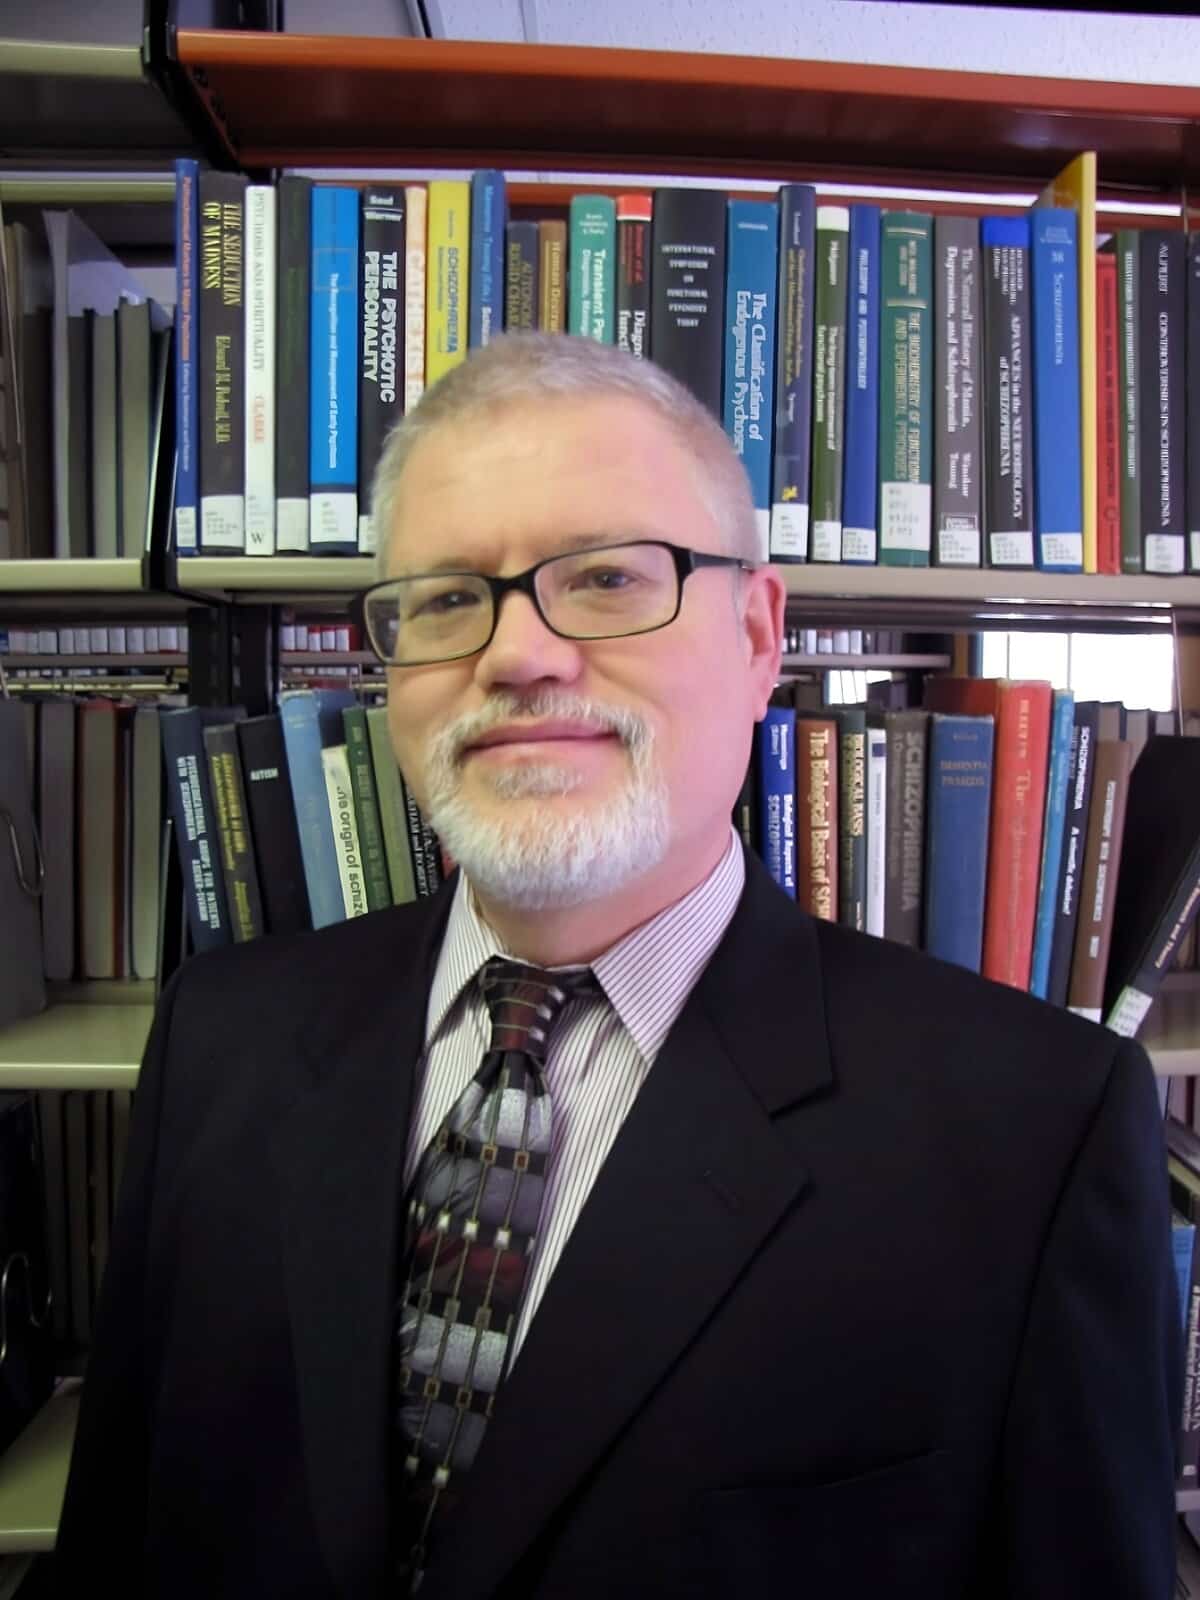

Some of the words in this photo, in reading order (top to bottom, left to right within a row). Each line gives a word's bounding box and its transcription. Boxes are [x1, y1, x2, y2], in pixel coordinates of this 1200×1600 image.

[202, 202, 221, 220] OF
[223, 202, 242, 230] THE
[254, 192, 265, 257] PSYCHOSIS
[202, 225, 221, 289] MADNESS
[223, 234, 242, 306] SEDUCTION
[254, 262, 265, 287] AND
[382, 252, 397, 291] THE
[962, 248, 973, 270] The
[446, 247, 460, 353] SCHIZOPHRENIA
[592, 248, 607, 315] Transient
[945, 247, 958, 318] Depression,
[961, 273, 973, 320] Natural
[364, 251, 380, 384] PERSONALITY
[751, 293, 767, 319] The
[253, 290, 265, 372] SPIRITUALITY
[380, 298, 396, 404] PSYCHOTIC
[731, 290, 751, 378] Endogenous
[947, 320, 958, 344] and
[959, 322, 973, 368] History
[1011, 315, 1022, 381] ADVANCES
[750, 323, 767, 420] Classification
[961, 370, 973, 384] of
[1000, 356, 1009, 368] of
[945, 345, 958, 433] Schizophrenia
[961, 386, 973, 427] Mania,
[1012, 383, 1021, 396] in
[1012, 397, 1021, 414] the
[749, 423, 765, 441] of
[999, 370, 1010, 476] SCHIZOPHRENIA
[1012, 416, 1023, 521] NEUROBIOLOGY
[1160, 428, 1170, 527] SCHIZOPHRENIA
[251, 532, 265, 545] W
[810, 729, 829, 757] The
[1073, 726, 1090, 811] SCHIZOPHRENIA
[808, 759, 830, 827] Biological
[341, 811, 355, 853] origin
[782, 794, 793, 838] Biological
[902, 732, 925, 912] SCHIZOPHRENIA
[346, 854, 360, 869] of
[811, 829, 830, 867] Basis
[785, 876, 794, 887] of
[811, 868, 830, 883] of
